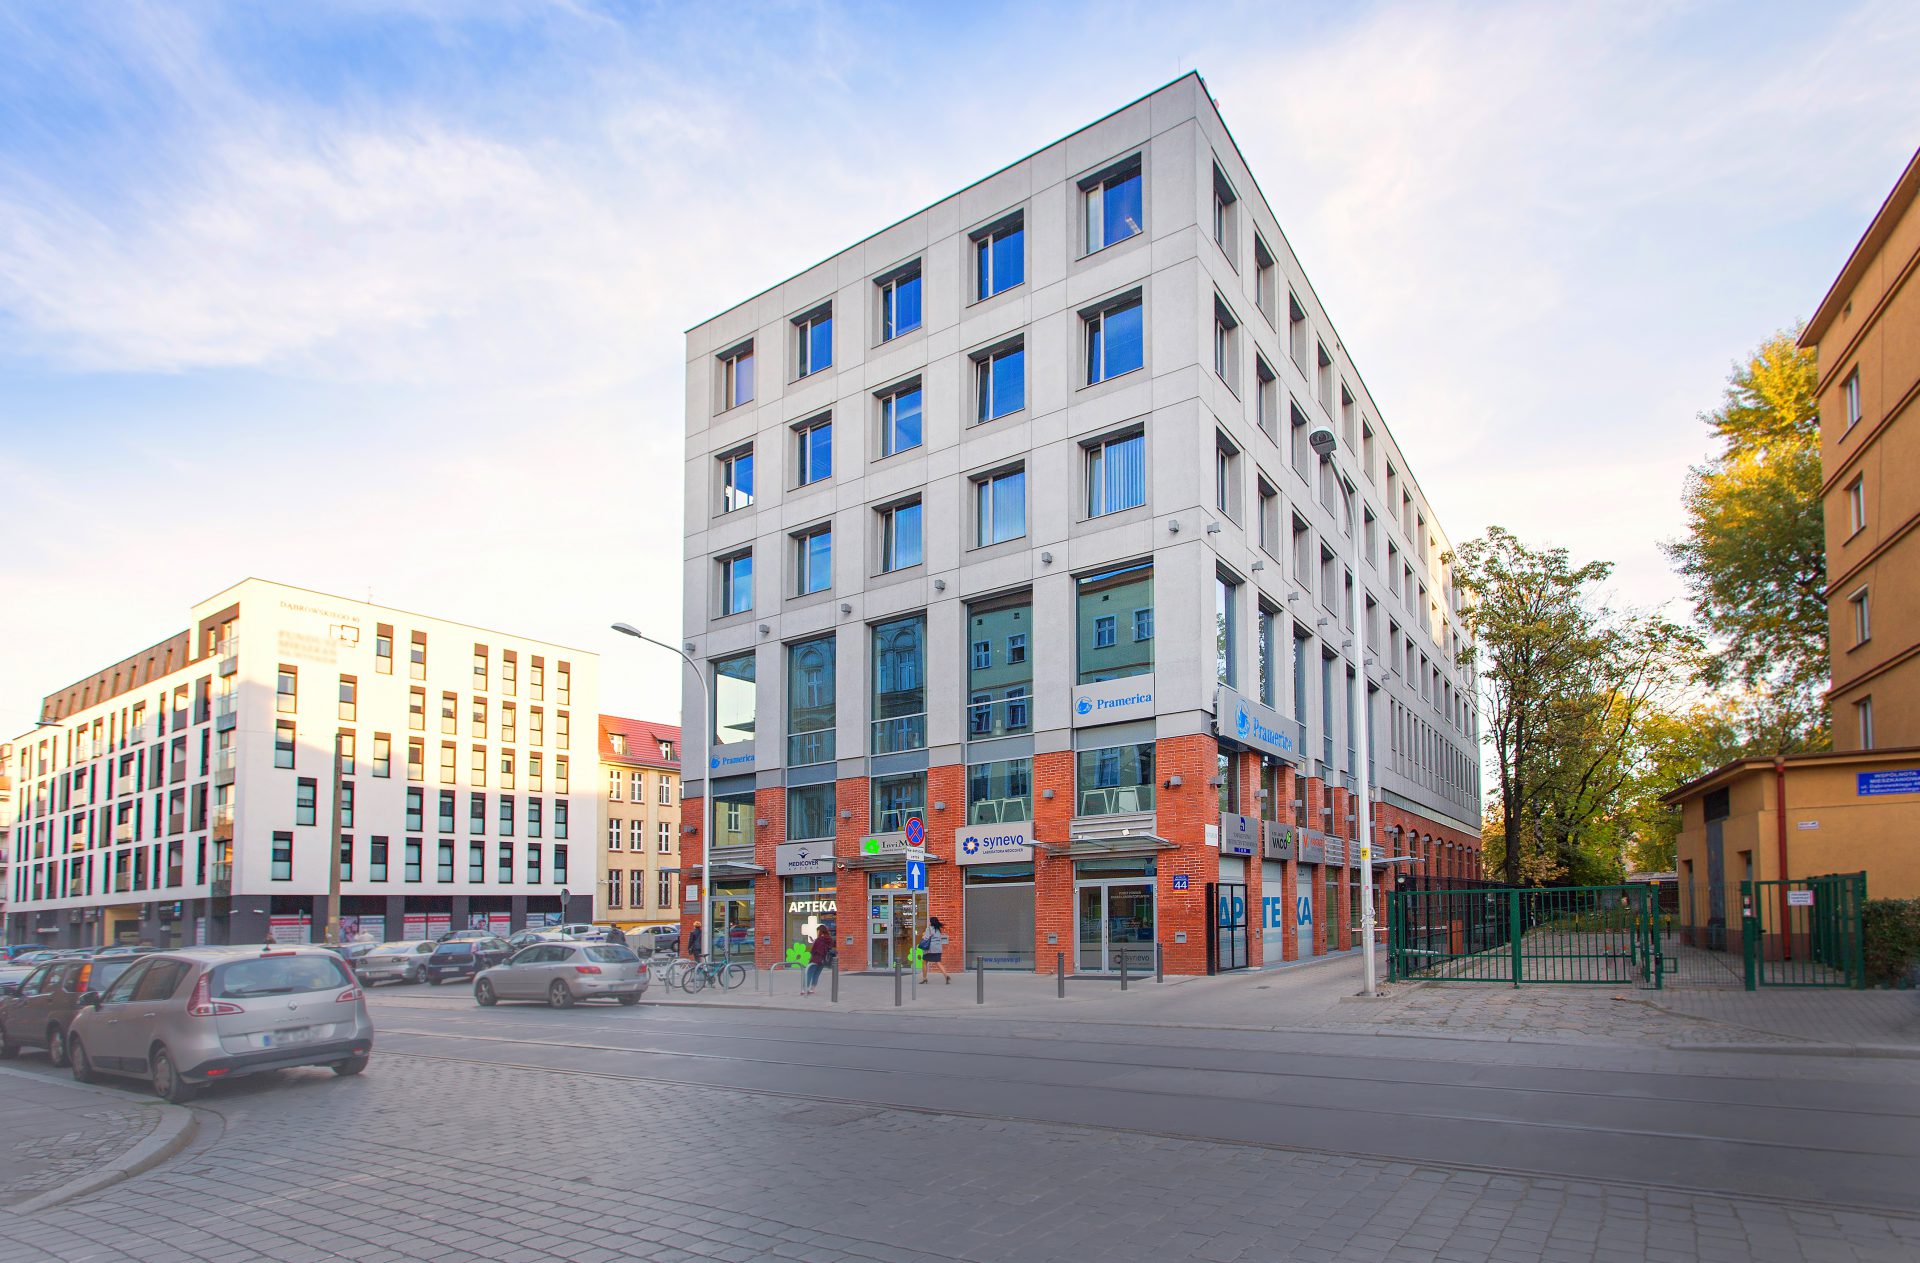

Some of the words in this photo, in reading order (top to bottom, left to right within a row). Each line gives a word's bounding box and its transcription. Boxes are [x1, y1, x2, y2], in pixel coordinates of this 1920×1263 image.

[1097, 693, 1152, 709] Pramerica
[1252, 717, 1293, 752] Pramerica
[722, 754, 755, 765] Pramerica
[983, 835, 1023, 849] synevo
[1174, 881, 1187, 889] 44
[789, 901, 838, 913] APTEKA
